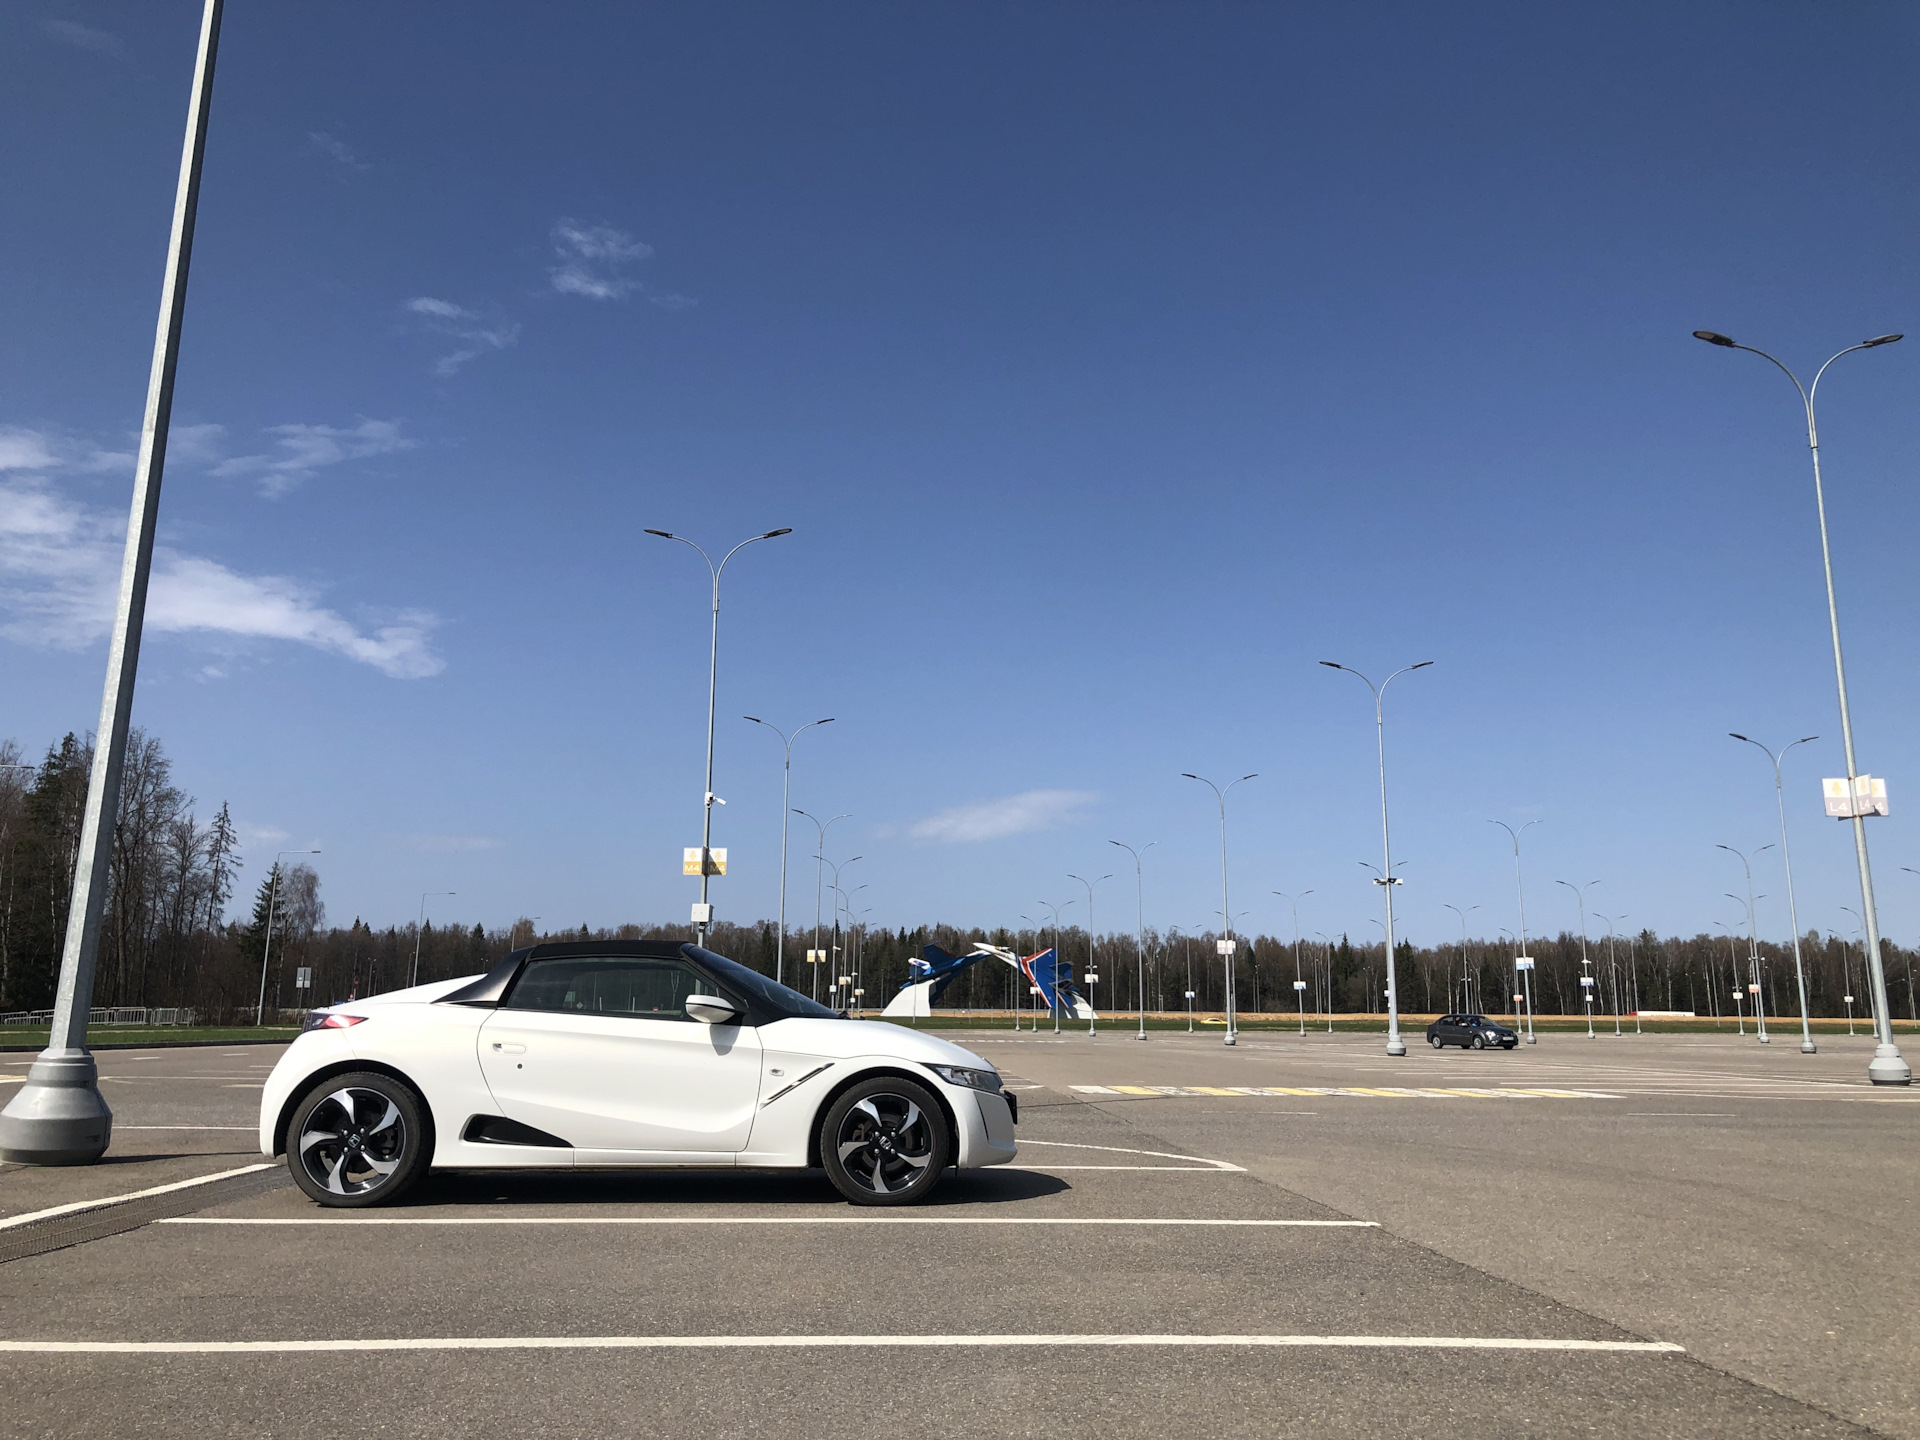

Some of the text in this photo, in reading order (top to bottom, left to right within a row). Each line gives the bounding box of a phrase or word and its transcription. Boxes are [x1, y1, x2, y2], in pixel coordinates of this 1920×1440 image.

[1829, 802, 1848, 812] L4
[1859, 798, 1870, 810] L4
[684, 864, 700, 872] M4
